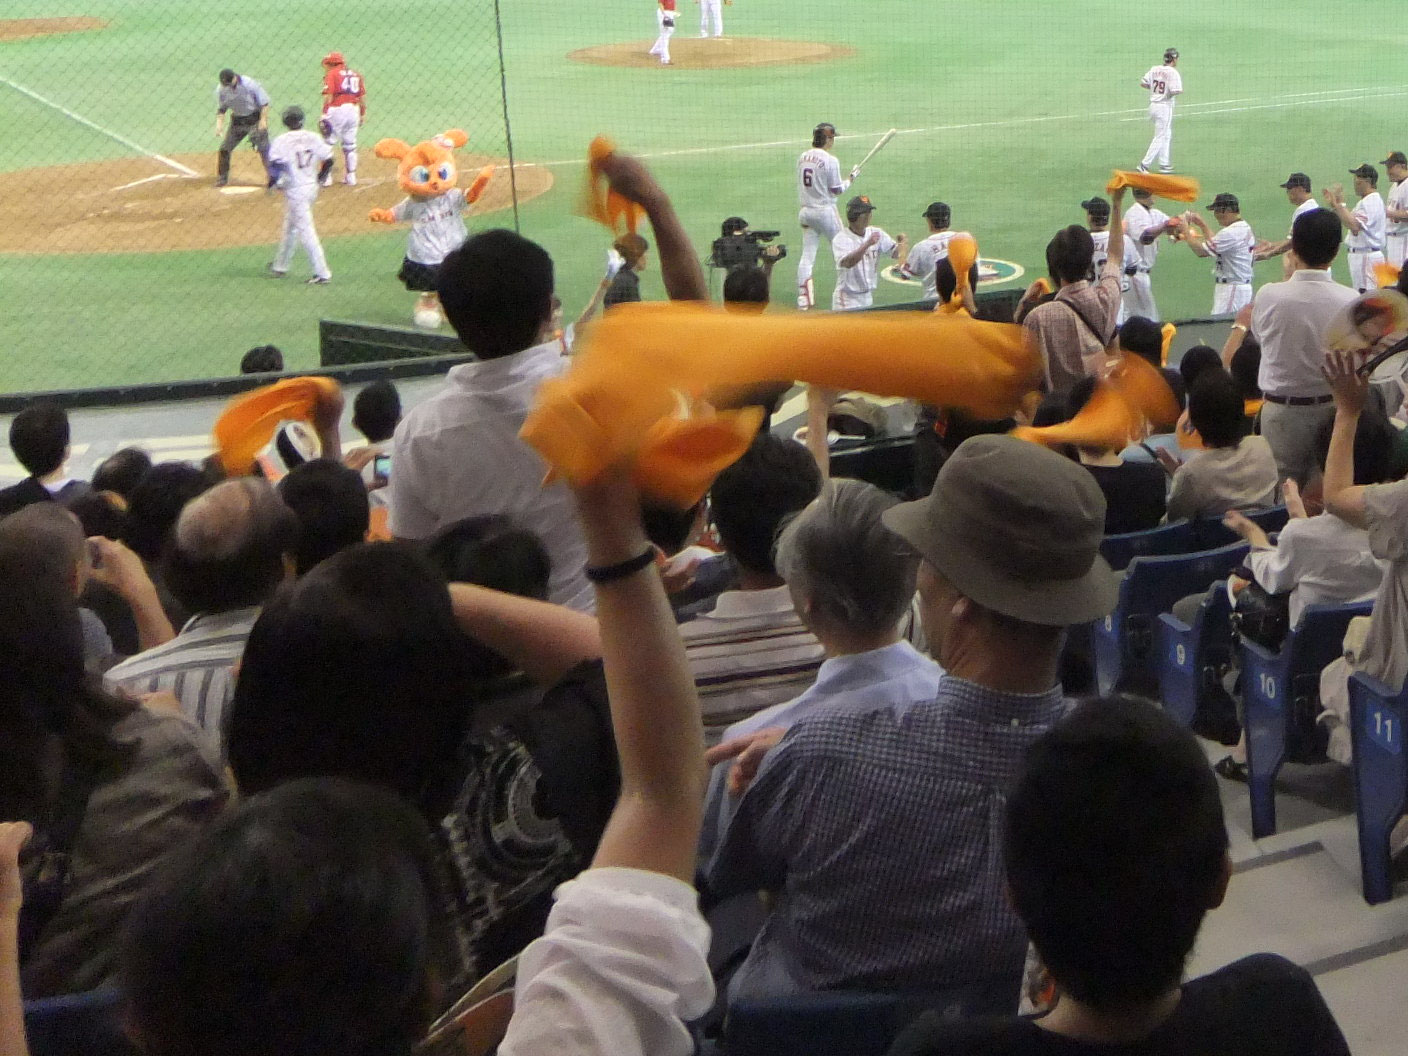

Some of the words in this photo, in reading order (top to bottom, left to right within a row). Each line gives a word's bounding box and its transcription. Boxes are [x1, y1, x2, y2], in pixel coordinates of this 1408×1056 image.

[341, 76, 360, 93] 40
[1153, 79, 1166, 94] 79
[295, 149, 314, 169] 17
[803, 168, 813, 187] 6
[1177, 643, 1185, 665] 9
[1259, 672, 1275, 699] 10
[1374, 711, 1392, 743] 11
